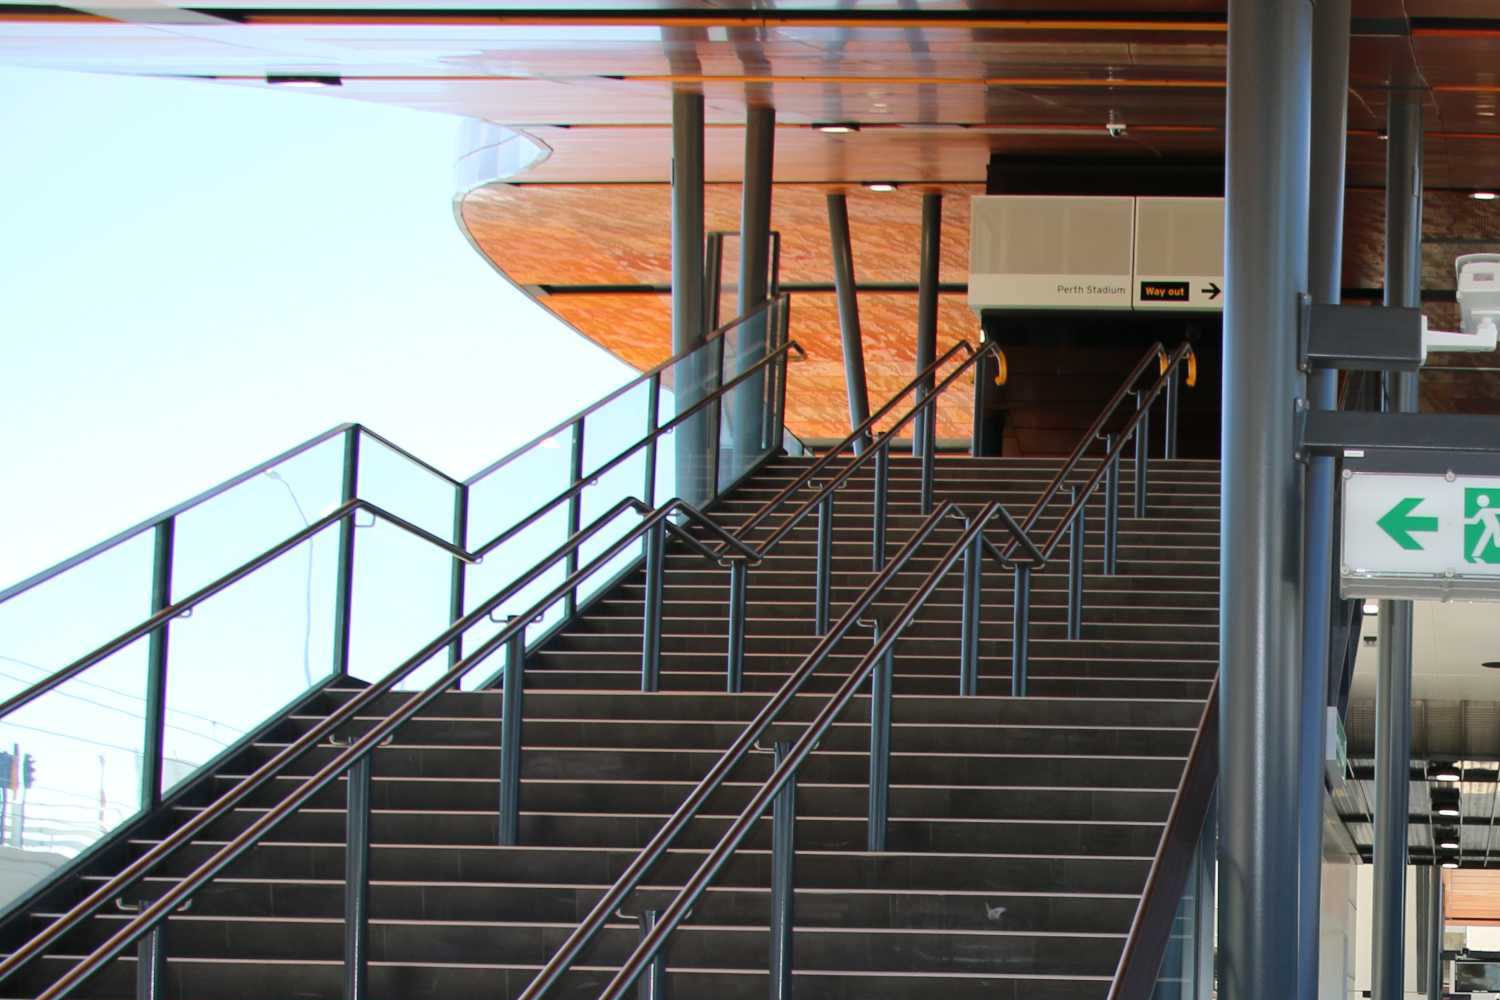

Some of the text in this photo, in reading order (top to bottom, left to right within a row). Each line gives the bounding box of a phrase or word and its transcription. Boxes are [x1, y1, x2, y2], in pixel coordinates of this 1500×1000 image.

[1057, 284, 1126, 295] Perth Stadium
[1145, 286, 1185, 297] Way out
